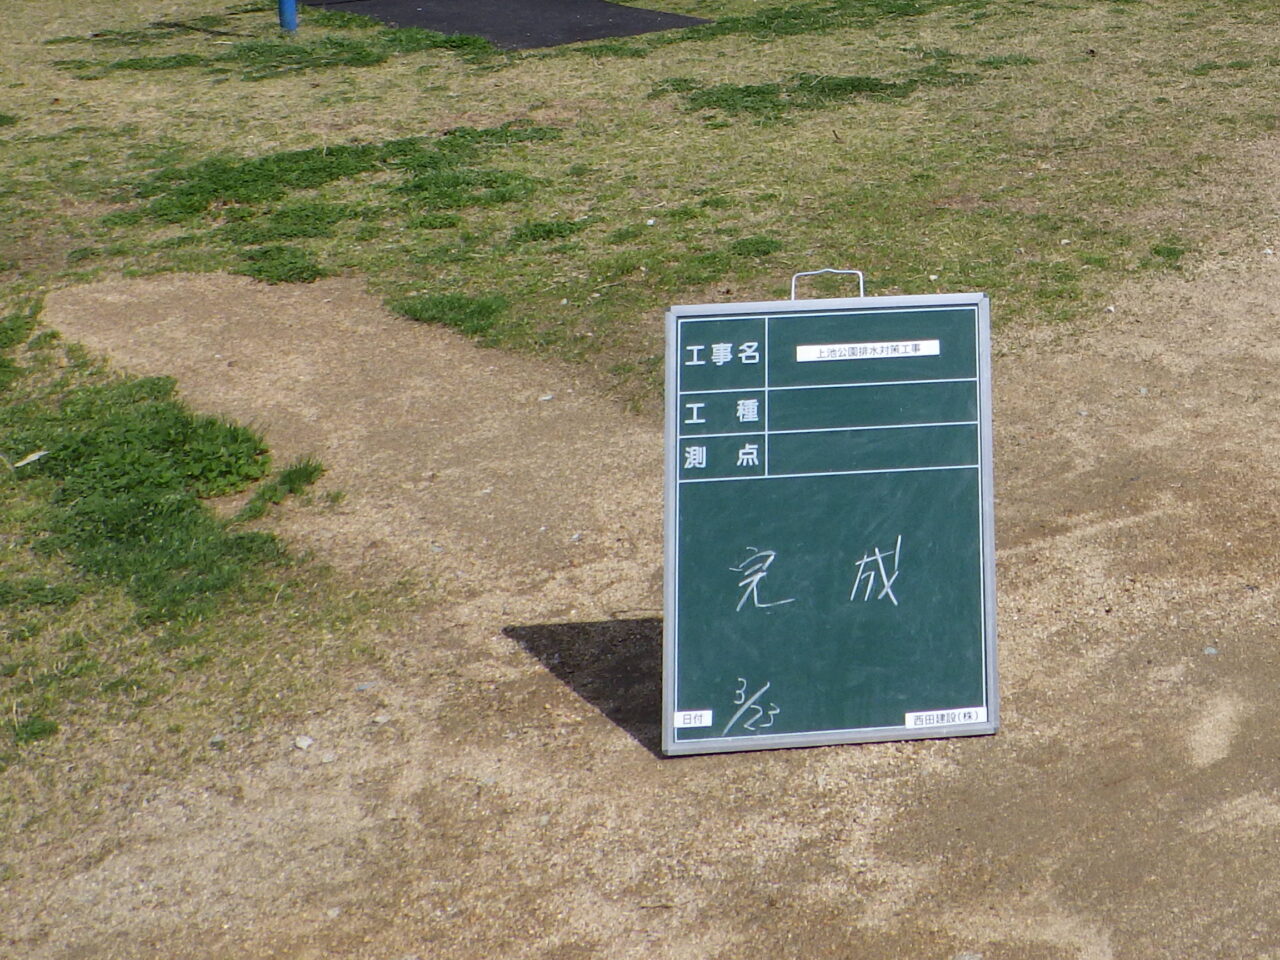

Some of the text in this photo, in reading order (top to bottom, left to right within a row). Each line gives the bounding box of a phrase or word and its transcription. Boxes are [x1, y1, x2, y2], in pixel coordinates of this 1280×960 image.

[684, 341, 760, 366] 工事名
[684, 399, 759, 424] 工種
[684, 443, 759, 468] 測点
[682, 713, 704, 725] 日付
